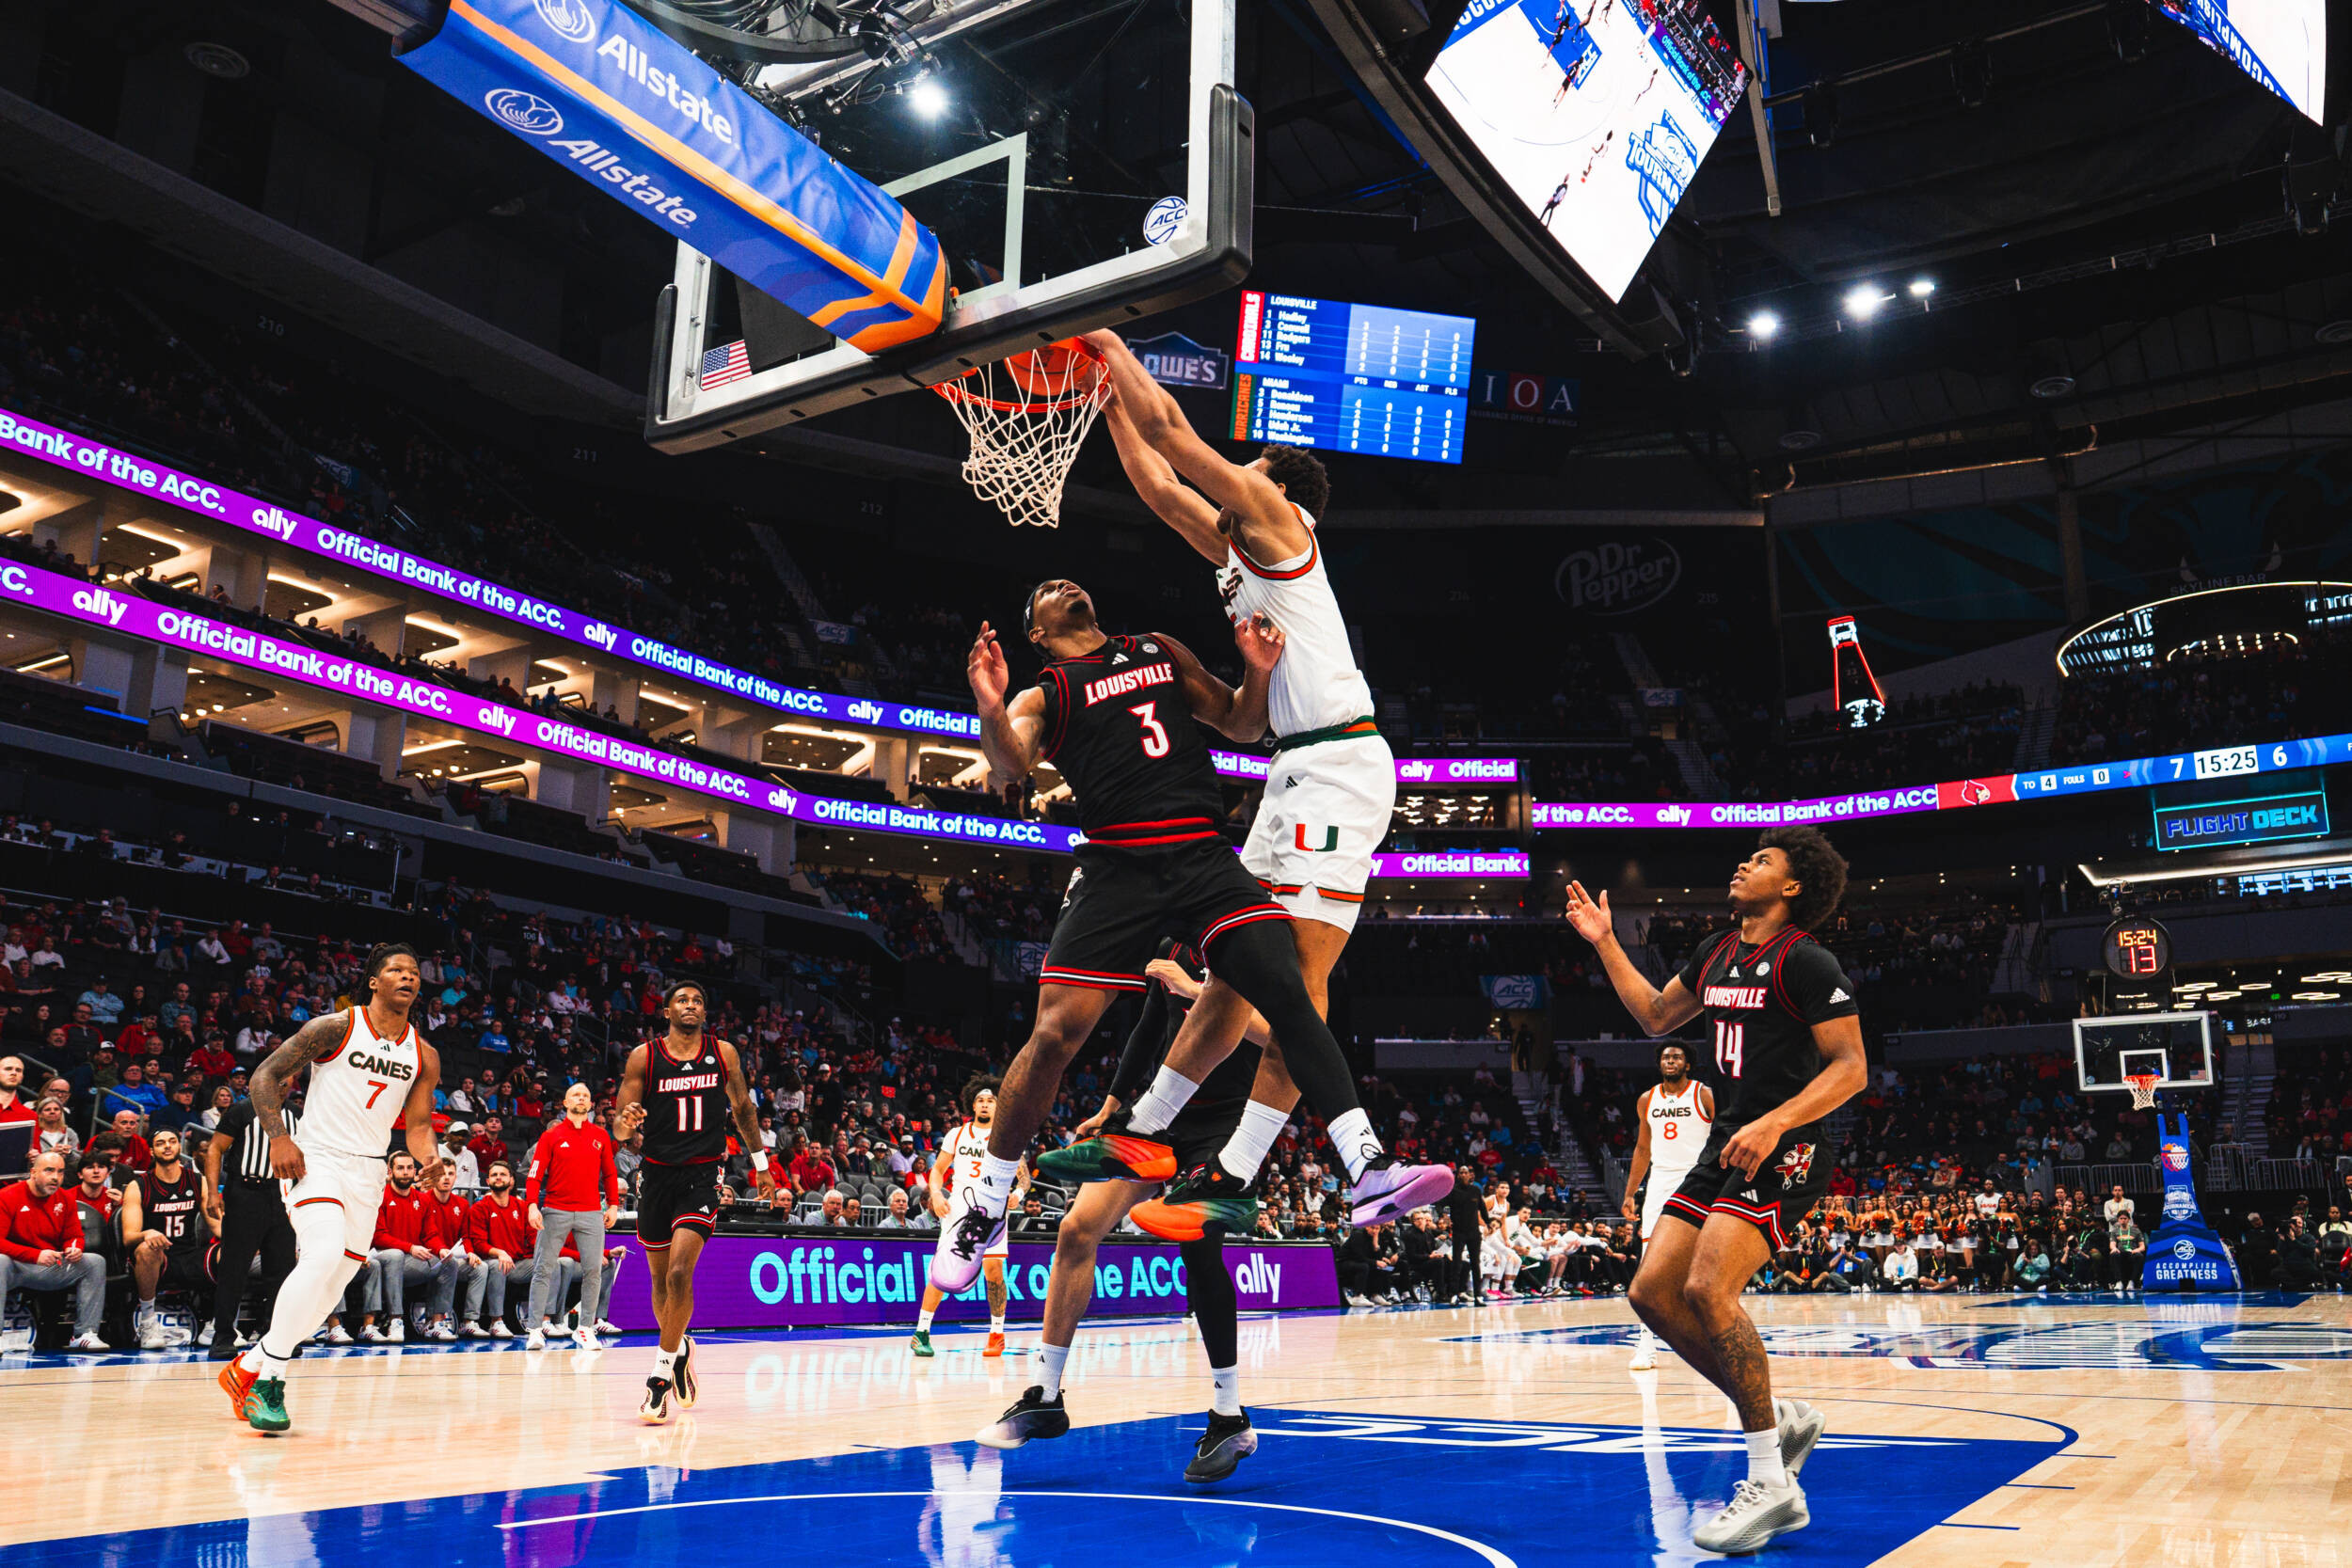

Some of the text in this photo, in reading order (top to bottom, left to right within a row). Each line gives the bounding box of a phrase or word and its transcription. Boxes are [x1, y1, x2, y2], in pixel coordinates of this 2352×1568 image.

[596, 34, 734, 145] Allstate
[548, 139, 698, 229] Allstate
[1150, 208, 1187, 228] ACC
[1266, 309, 1272, 318] 1
[1270, 296, 1317, 309] LOUISVILLE
[257, 314, 284, 336] 210
[1240, 293, 1261, 361] CARDINALS
[1263, 330, 1273, 339] 11
[1264, 321, 1271, 329] 3
[1260, 351, 1271, 361] 14
[1261, 340, 1272, 350] 13
[1258, 388, 1264, 397] 3
[1354, 376, 1368, 386] PTS
[1415, 384, 1429, 393] AST
[1445, 387, 1458, 396] FLS
[1483, 374, 1573, 412] IOA
[1233, 373, 1252, 440] HURRICANES
[1256, 408, 1263, 418] 7
[1257, 398, 1263, 407] 5
[1252, 429, 1263, 439] 10
[1255, 419, 1262, 428] 8
[0, 414, 226, 514] Bank of the ACC.
[572, 447, 597, 463] 211
[860, 500, 883, 515] 212
[251, 507, 298, 541] ally
[1597, 542, 1641, 575] Dr
[316, 528, 566, 631] Official Bank of the ACC.
[1562, 550, 1672, 608] Pepper
[2169, 572, 2267, 596] SKYLINE BAR
[72, 589, 128, 626] ally
[583, 623, 618, 652] ally
[157, 611, 453, 715] Official Bank of the ACC.
[631, 638, 829, 715] Official Bank of the ACC.
[1085, 661, 1175, 708] LOUISVILLE
[479, 705, 516, 736] ally
[848, 700, 883, 724] ally
[898, 707, 966, 734] Official
[1128, 700, 1171, 760] 3
[536, 722, 750, 798] Official Bank of the ACC.
[1401, 760, 1434, 781] ally
[1449, 760, 1515, 778] Official
[2169, 747, 2287, 778] 7 15:25 6
[2024, 771, 2106, 789] TO 4 FOULS 0
[768, 788, 798, 815] ally
[1711, 805, 1780, 823] Official
[1783, 800, 1833, 823] Bank
[1835, 796, 1854, 816] of
[1855, 792, 1889, 813] the
[813, 800, 887, 826] Official
[889, 808, 940, 832] Bank
[941, 815, 964, 834] of
[963, 817, 996, 839] the
[999, 822, 1046, 844] ACC.
[1533, 806, 1634, 824] of the ACC.
[1657, 804, 1692, 827] ally
[2166, 805, 2318, 838] FLIGHT DECK
[1295, 823, 1339, 852] U
[1402, 856, 1470, 872] Official
[1472, 856, 1521, 872] Bank
[2119, 929, 2157, 946] 15:24
[2130, 945, 2156, 973] 13
[1495, 985, 1530, 995] ACC
[1704, 986, 1768, 1009] LOUISVILLE
[1714, 1019, 1743, 1079] 14
[347, 1051, 414, 1081] CANES
[365, 1080, 388, 1109] 7
[658, 1073, 719, 1093] LOUISVILLE
[676, 1095, 703, 1132] 11
[1652, 1106, 1692, 1118] CANES
[1663, 1121, 1677, 1140] 8
[959, 1147, 985, 1158] CAN
[969, 1161, 982, 1179] 3
[153, 1199, 195, 1213] LOUISVILLE
[165, 1215, 185, 1238] 15
[2176, 1245, 2195, 1254] ACC
[750, 1245, 917, 1306] Official
[1236, 1253, 1281, 1304] ally
[2156, 1270, 2217, 1280] GREATNESS
